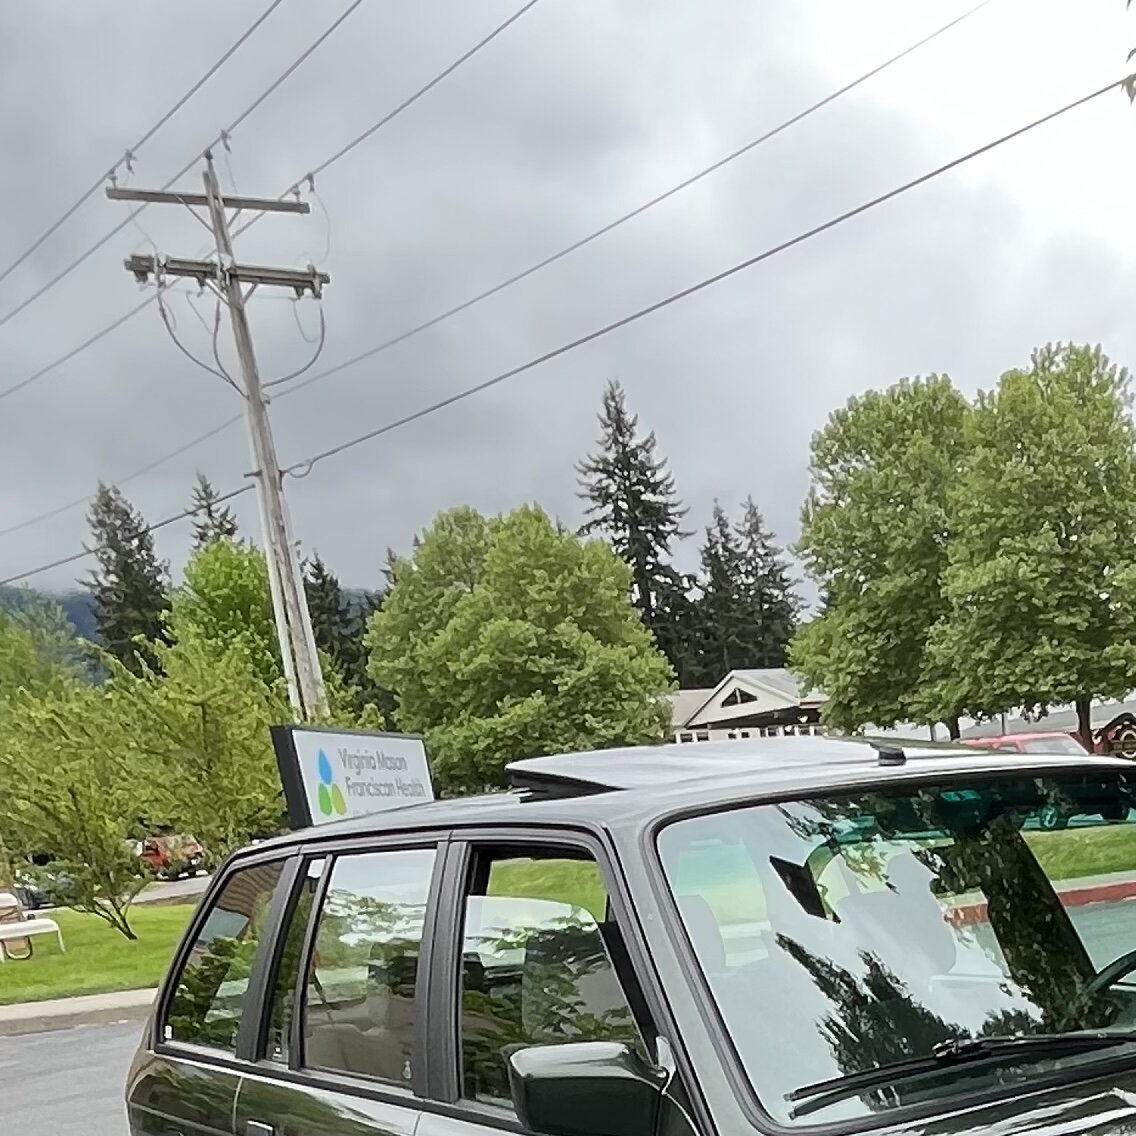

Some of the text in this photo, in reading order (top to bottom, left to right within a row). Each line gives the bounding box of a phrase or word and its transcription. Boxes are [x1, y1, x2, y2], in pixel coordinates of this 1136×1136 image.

[338, 747, 408, 775] Virginia Mason
[345, 775, 426, 797] Franciscan Health
